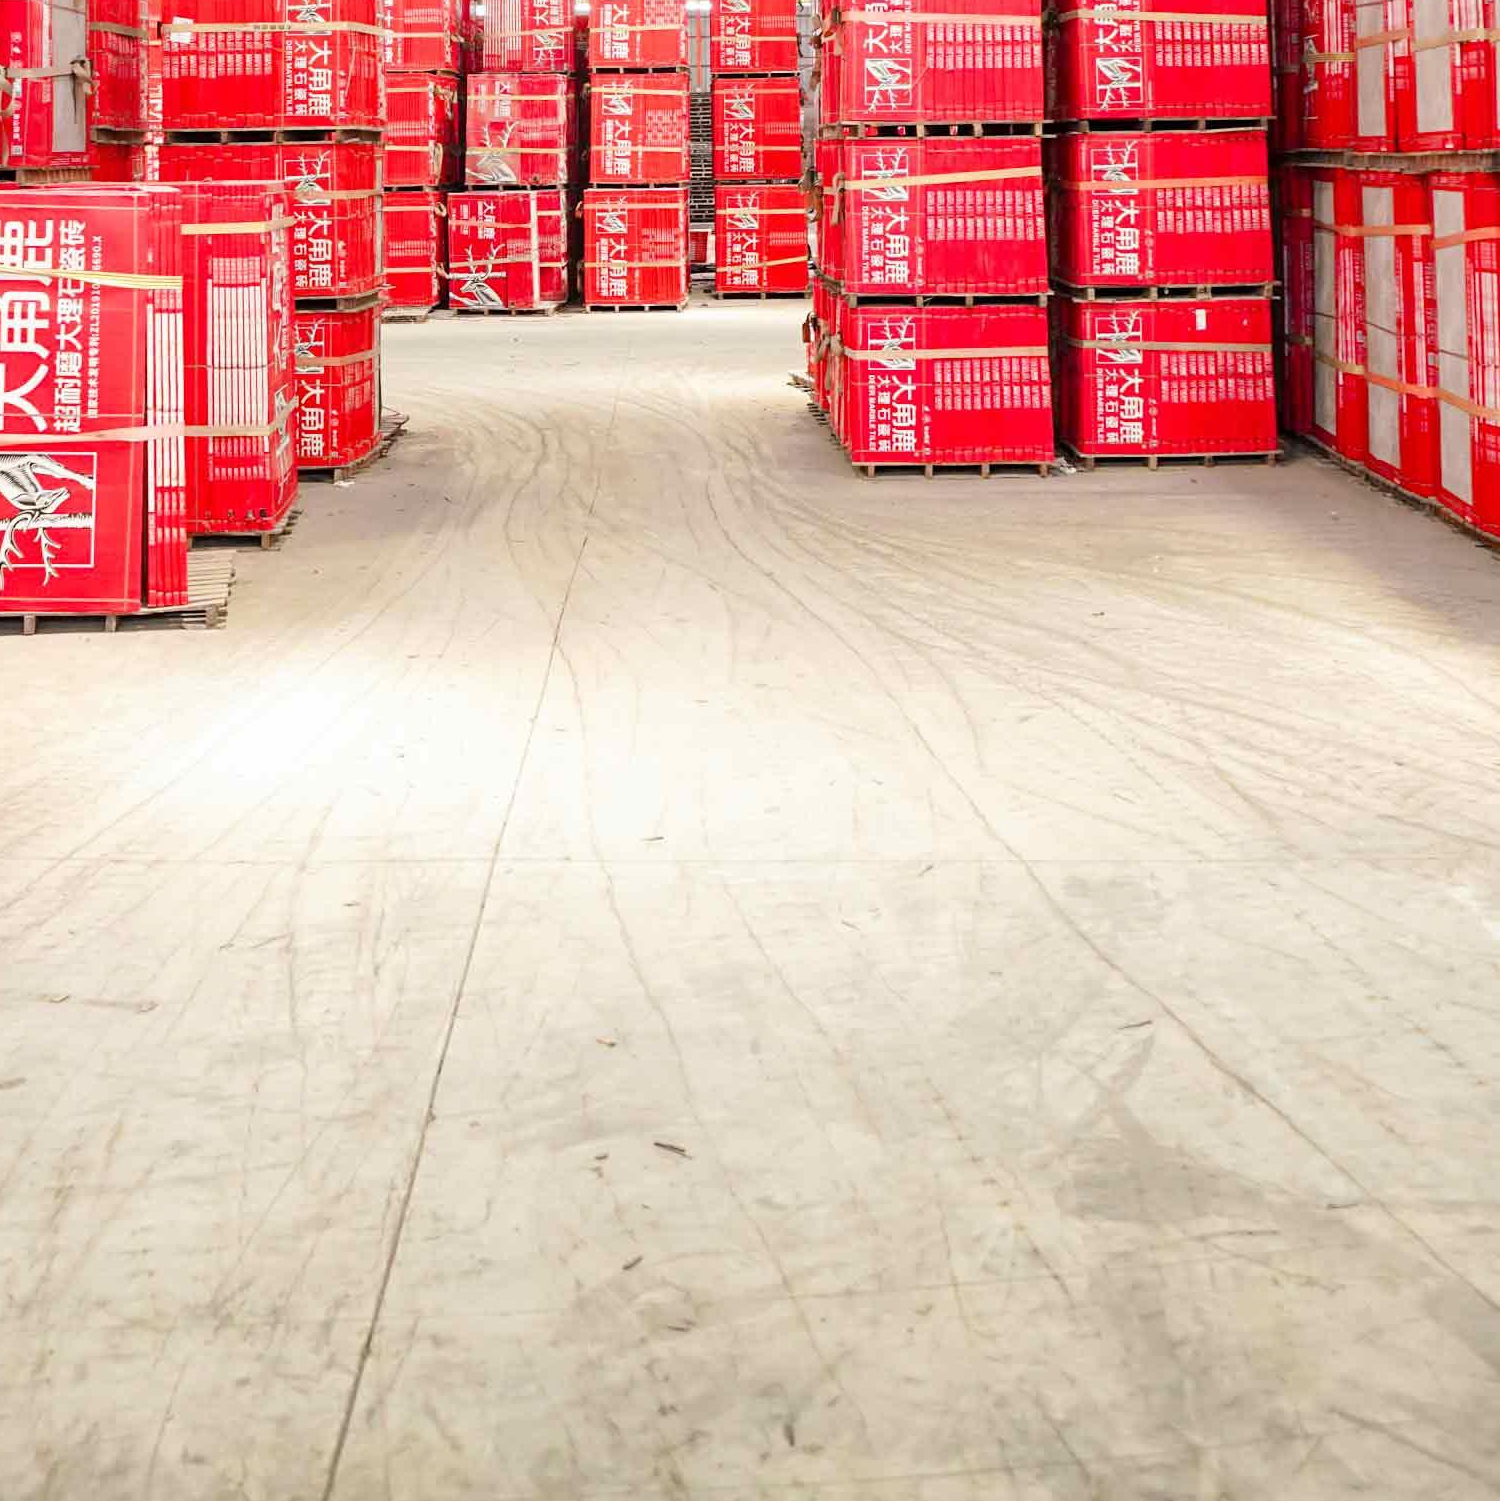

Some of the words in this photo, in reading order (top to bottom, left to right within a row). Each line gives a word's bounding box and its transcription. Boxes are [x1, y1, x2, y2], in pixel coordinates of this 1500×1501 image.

[308, 41, 332, 116] 大角鹿
[308, 211, 332, 288] 大角鹿
[609, 238, 628, 296] 大角鹿
[741, 232, 759, 285] 大角鹿
[884, 206, 910, 284] 大角鹿
[1115, 199, 1139, 276] 大角鹿
[88, 236, 102, 419] 国家技术发明专利:ZL2019106690.X
[299, 378, 326, 458] 大角鹿
[891, 375, 917, 452] 大角鹿
[1119, 369, 1144, 445] 大角鹿
